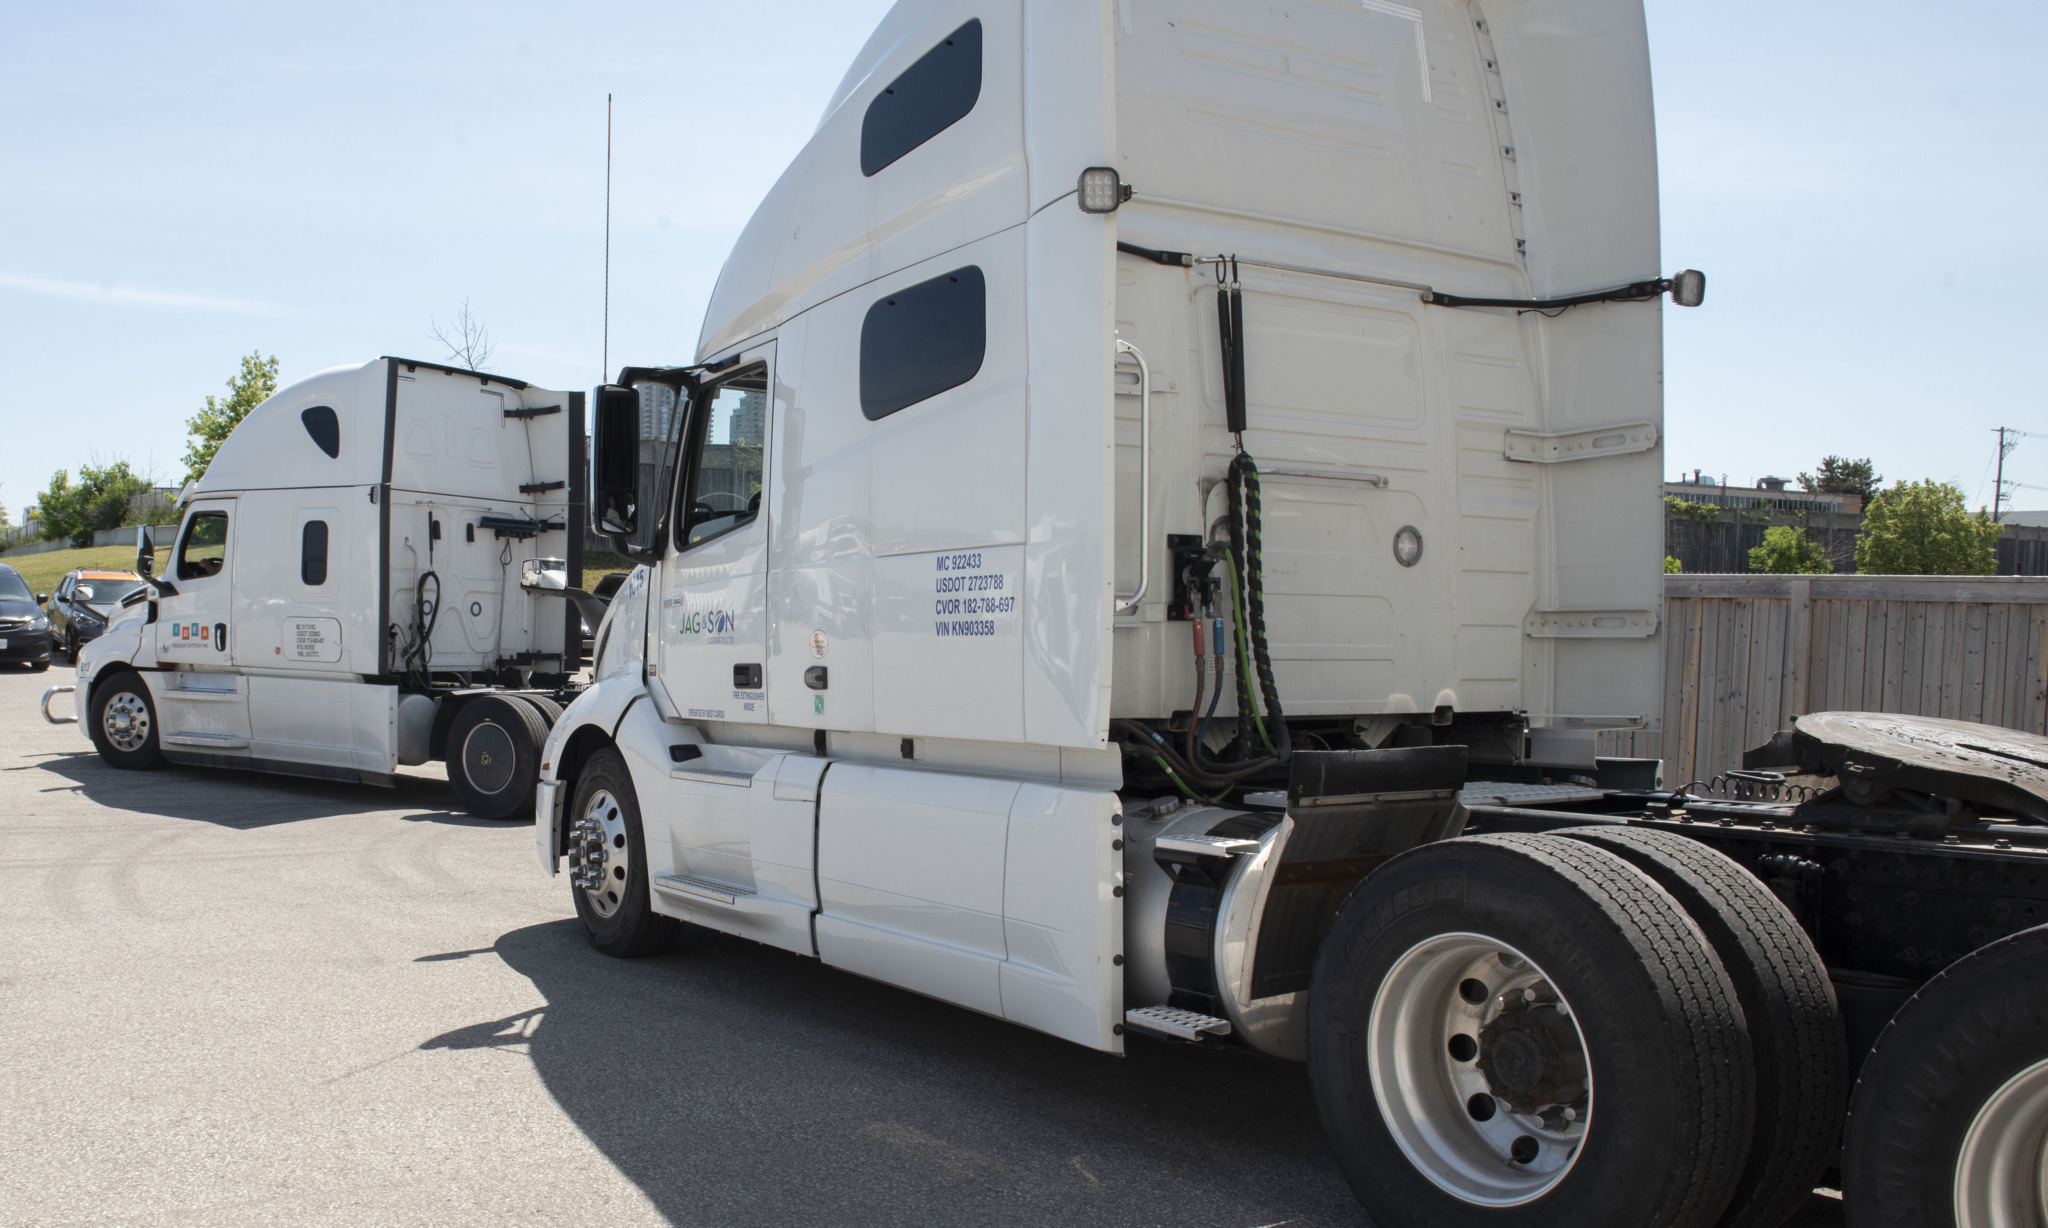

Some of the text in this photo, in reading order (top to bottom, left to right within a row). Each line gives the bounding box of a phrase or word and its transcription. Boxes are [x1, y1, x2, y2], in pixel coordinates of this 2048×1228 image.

[936, 553, 982, 571] MC 922433
[936, 574, 1004, 593] USDOT 2723788
[935, 596, 1015, 615] CVOR 182-788-697
[174, 624, 208, 639] IDEA
[935, 619, 995, 637] VIN KN903358
[733, 691, 765, 701] FIRE EXTINGUISHER
[743, 702, 755, 711] INSIDE
